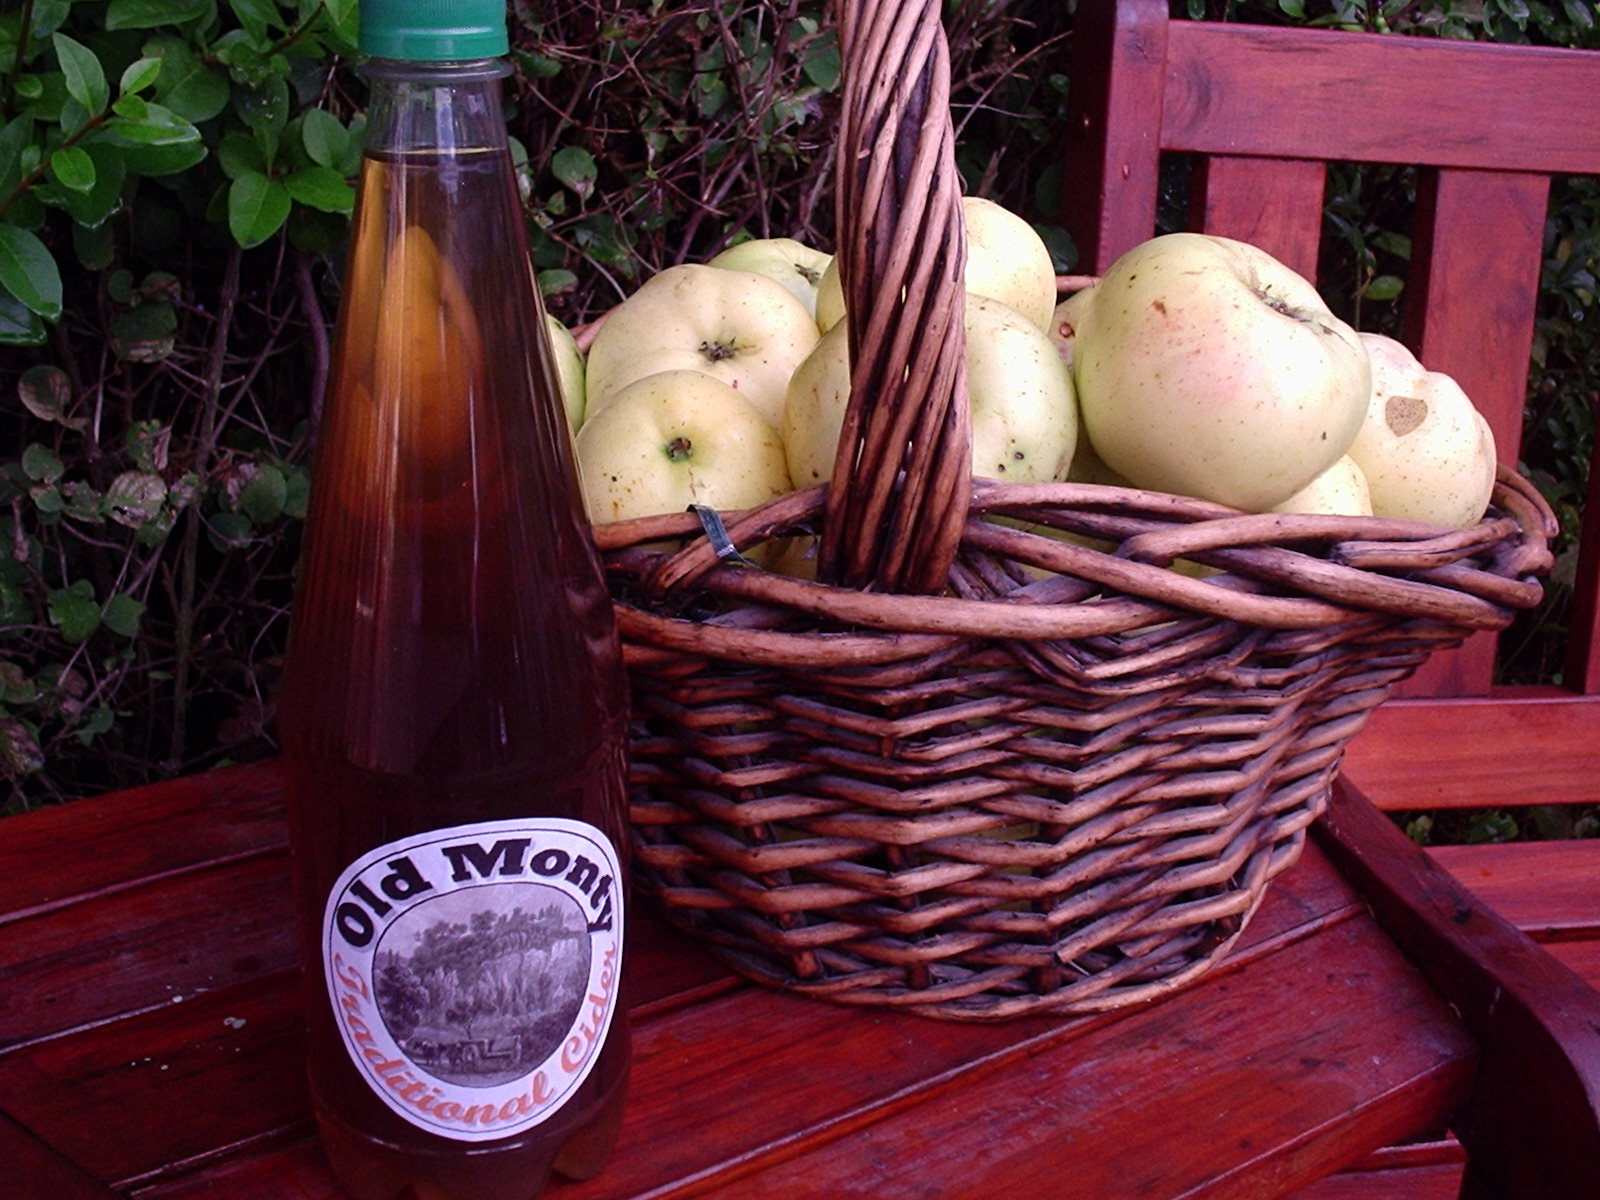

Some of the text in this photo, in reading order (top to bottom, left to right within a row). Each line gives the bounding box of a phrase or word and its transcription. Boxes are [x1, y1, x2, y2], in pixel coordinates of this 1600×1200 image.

[336, 838, 613, 947] Old Monty
[333, 942, 616, 1124] Traditional Cider
